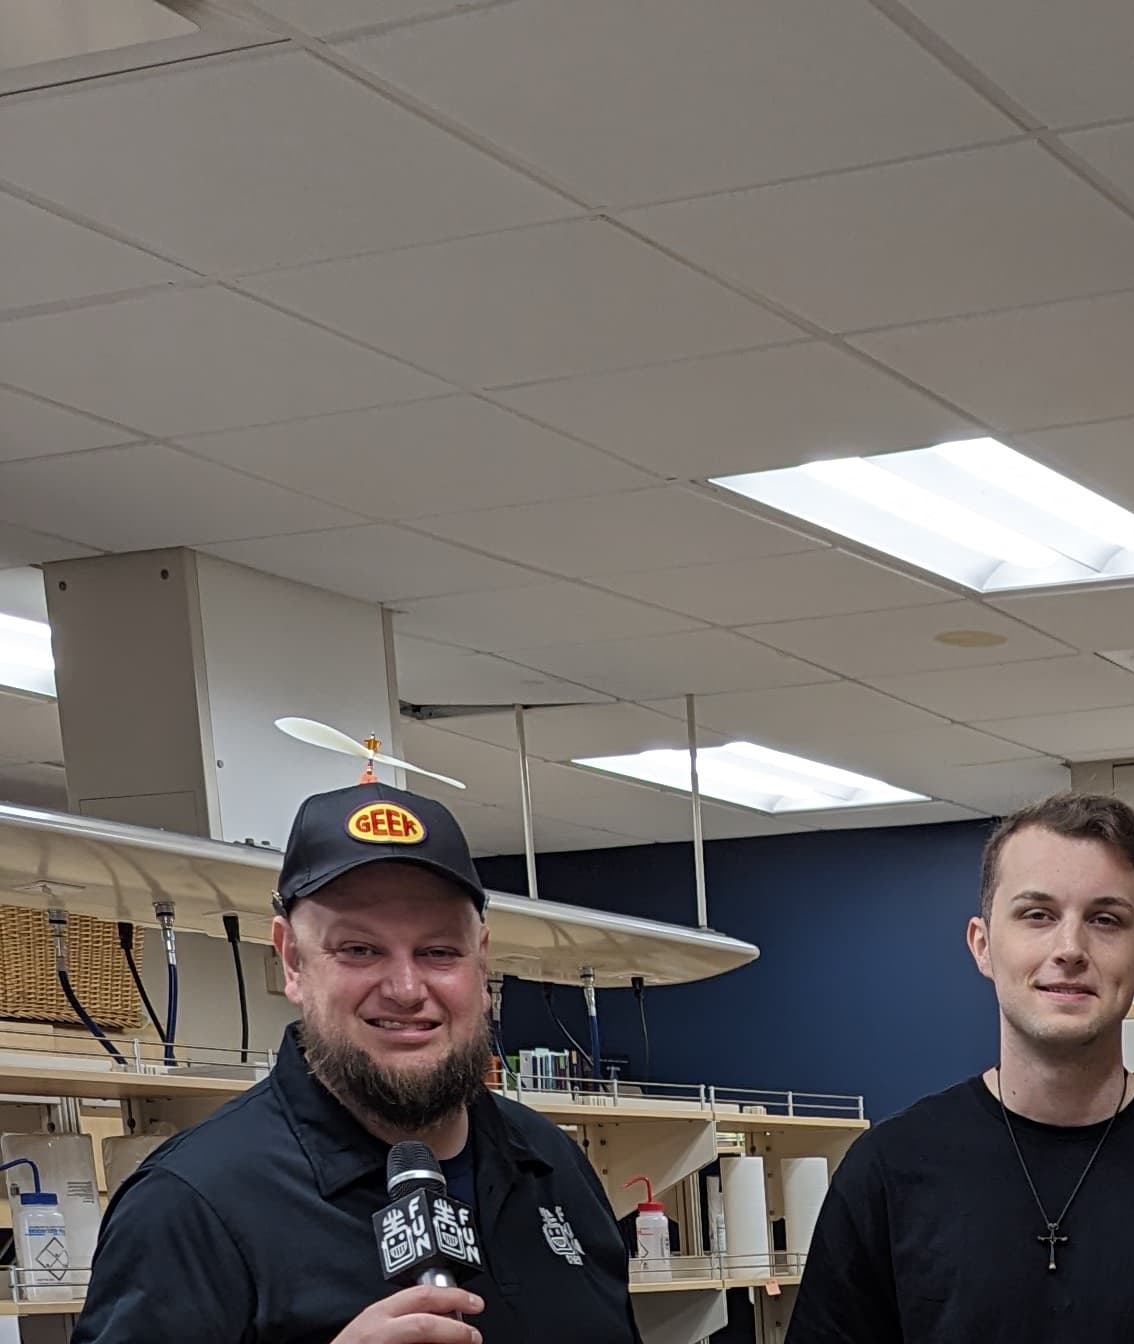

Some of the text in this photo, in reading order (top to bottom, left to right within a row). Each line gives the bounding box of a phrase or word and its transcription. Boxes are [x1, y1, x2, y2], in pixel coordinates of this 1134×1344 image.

[355, 809, 418, 837] GEEK
[408, 1196, 432, 1257] FUN
[458, 1208, 481, 1265] FUN
